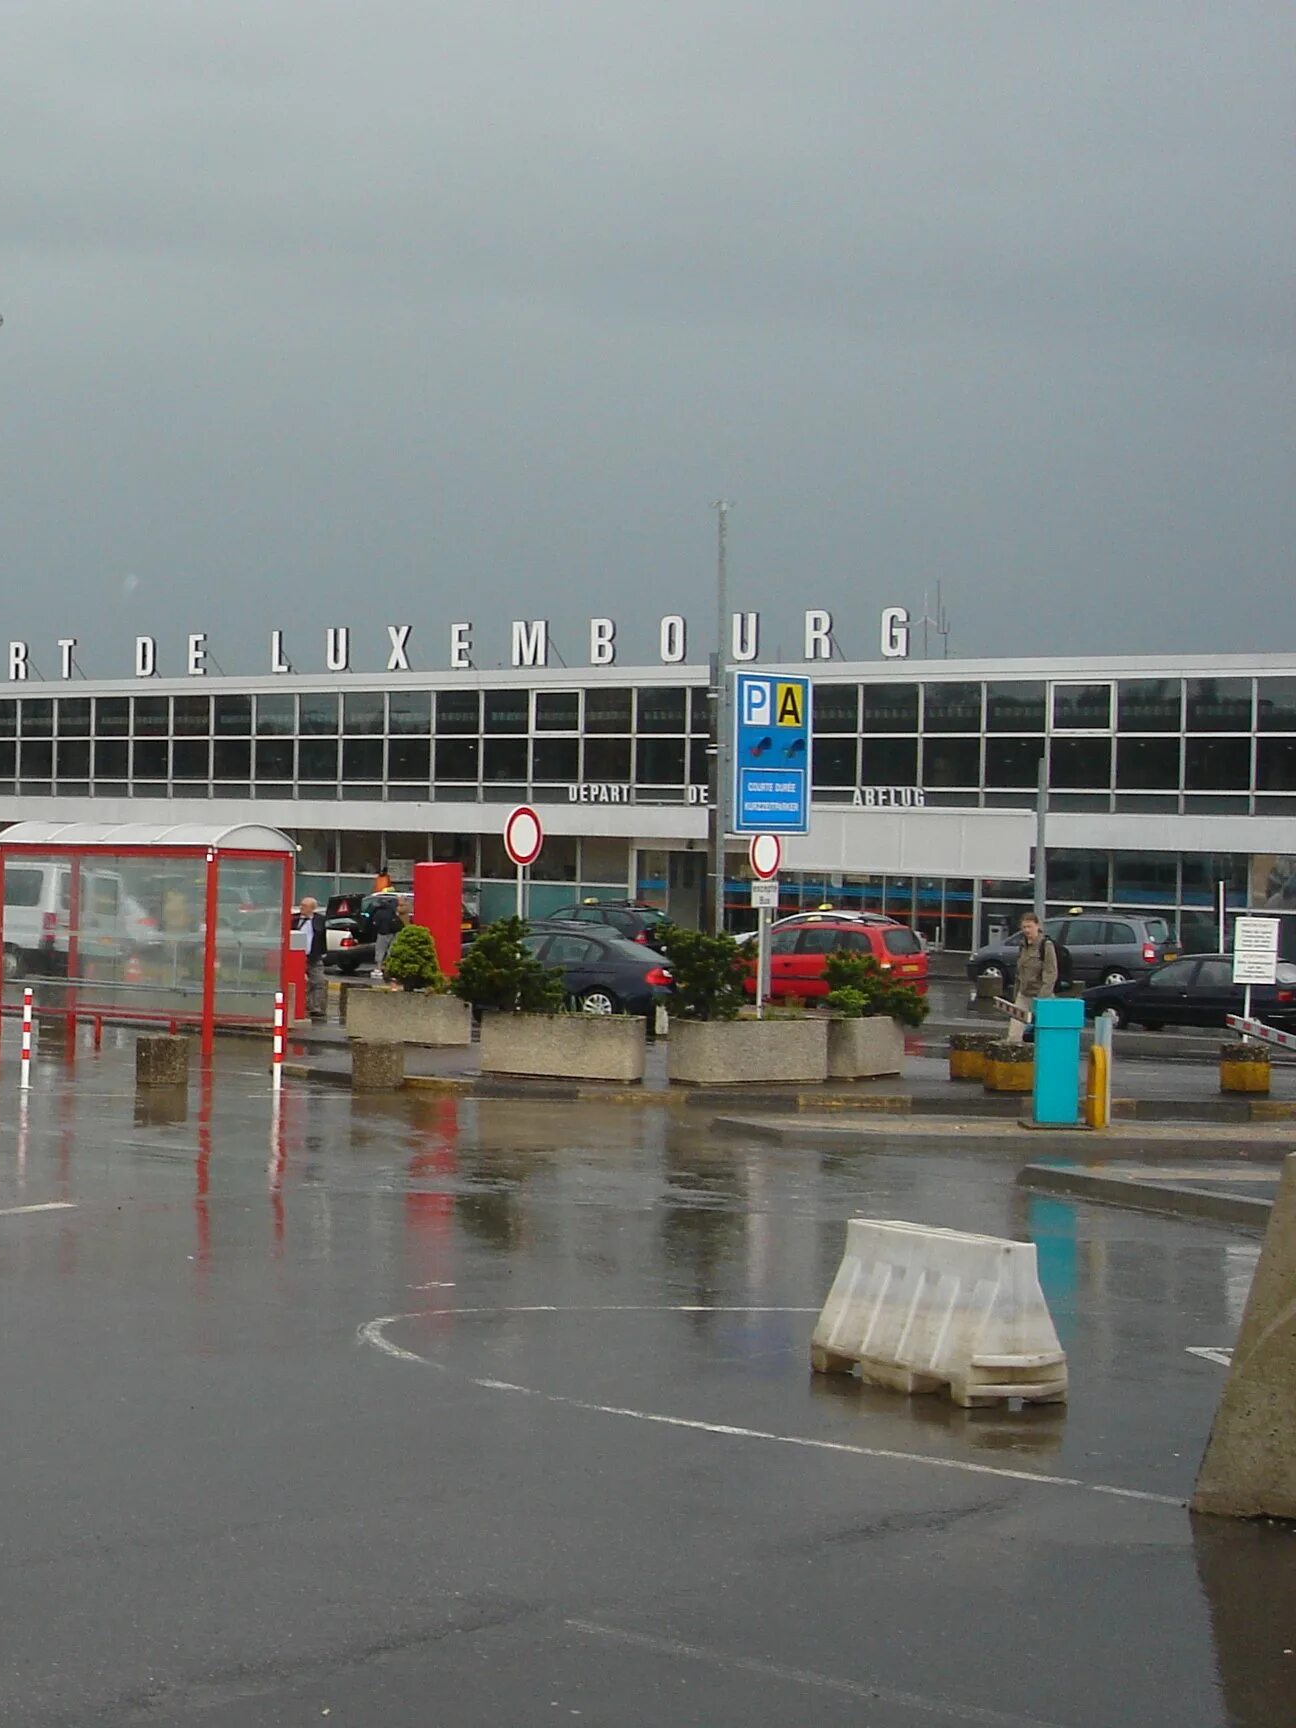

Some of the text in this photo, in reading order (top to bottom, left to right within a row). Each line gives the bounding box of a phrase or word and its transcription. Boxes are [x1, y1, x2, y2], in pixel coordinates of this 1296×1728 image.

[136, 633, 207, 678] DE
[271, 606, 909, 673] LUXEMBOURG
[747, 684, 800, 724] P A
[569, 784, 630, 802] DEPART
[853, 788, 925, 806] ABFLUG
